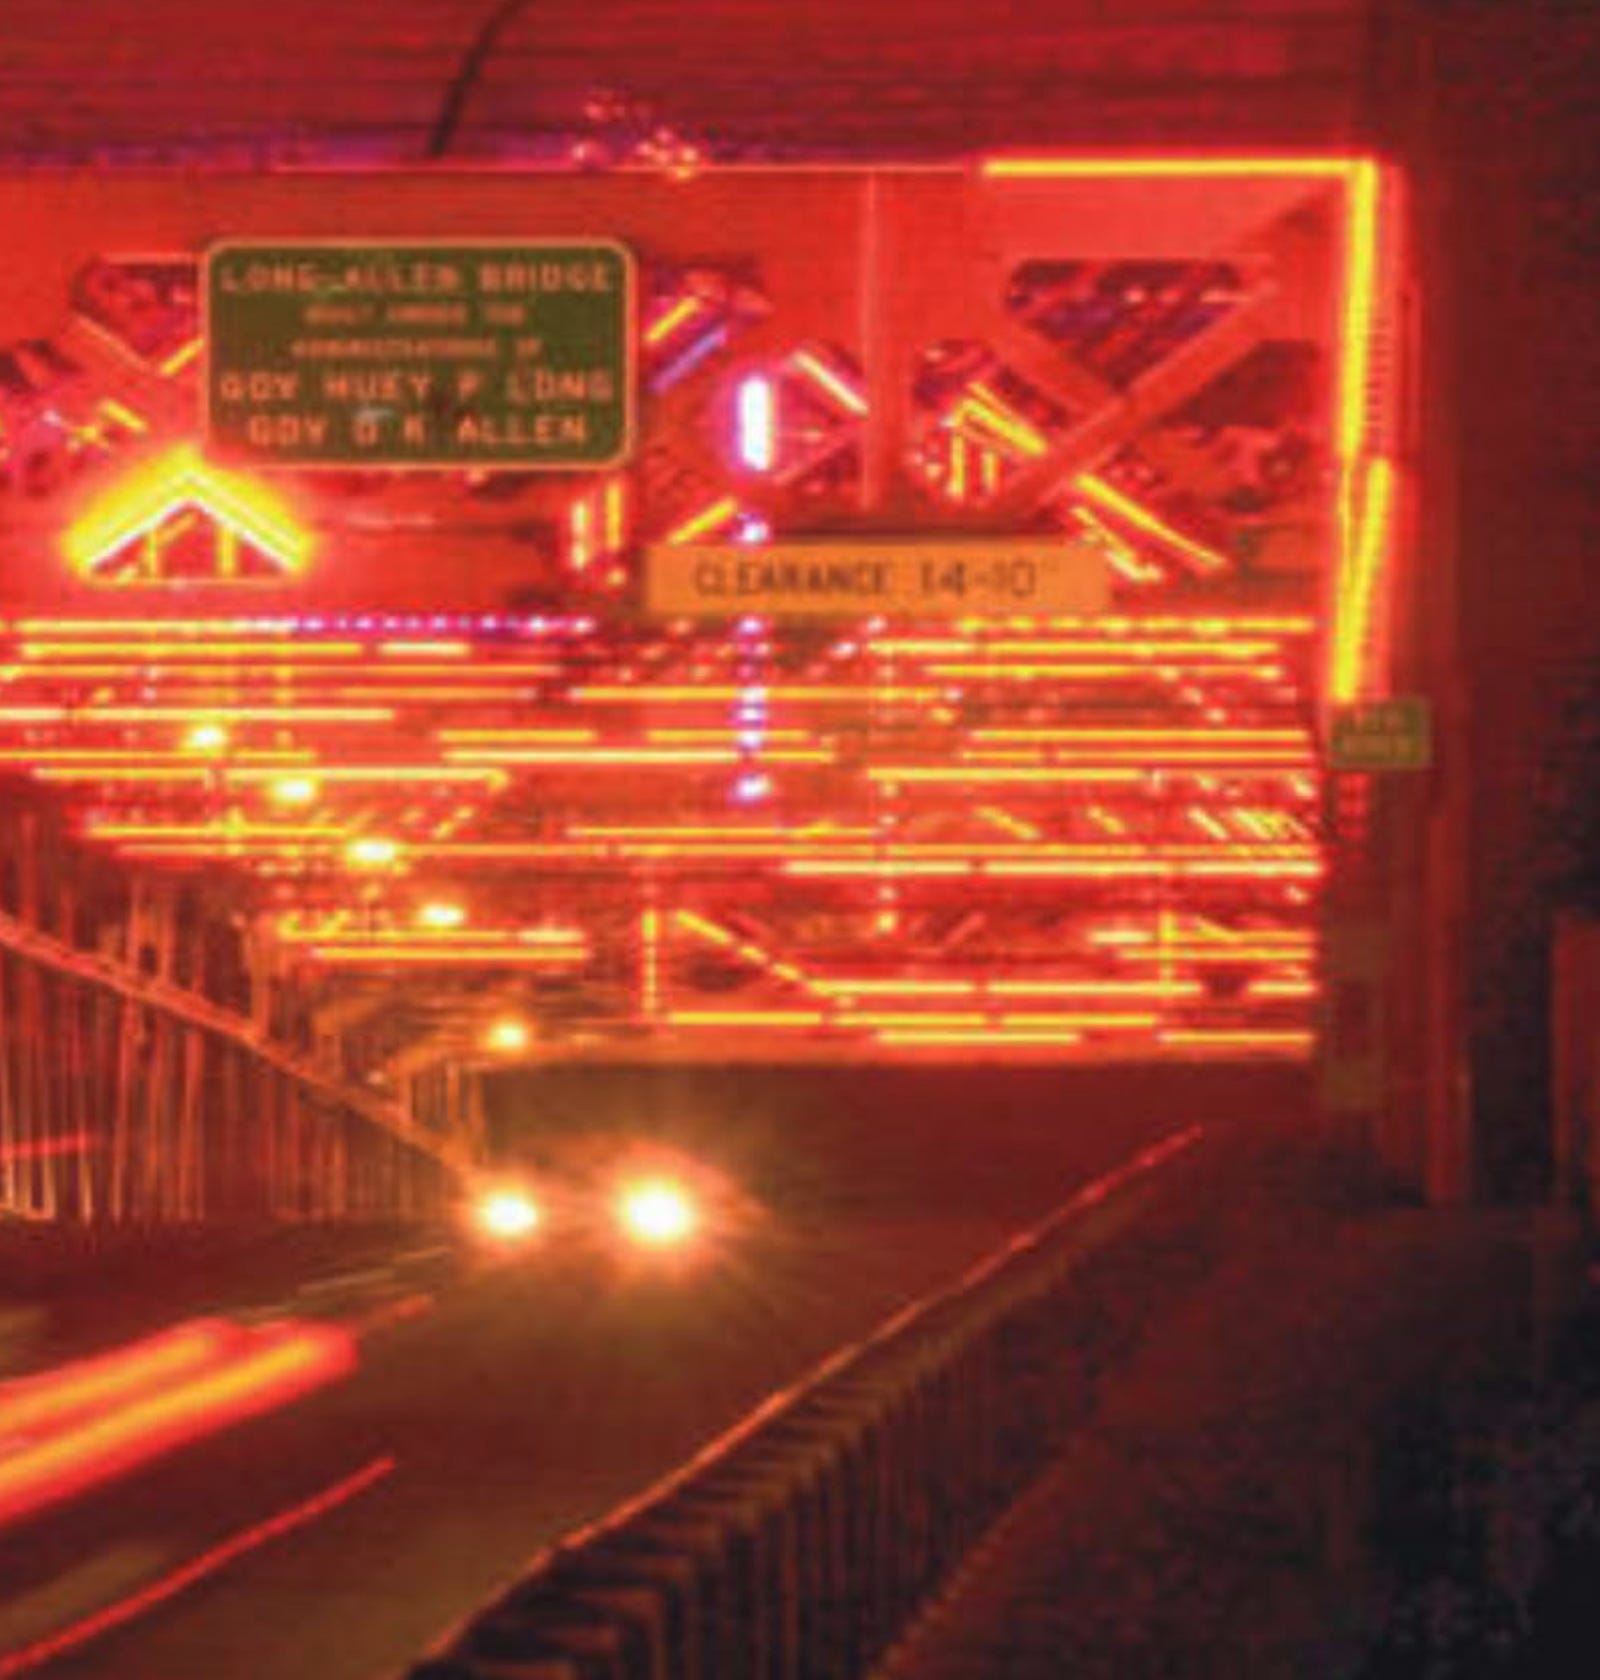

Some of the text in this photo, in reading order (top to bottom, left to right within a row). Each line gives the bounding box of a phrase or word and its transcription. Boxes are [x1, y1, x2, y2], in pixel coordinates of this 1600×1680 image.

[480, 263, 610, 292] BRIDGE
[219, 369, 613, 400] GOV HUEY P LONG
[248, 414, 328, 444] GOV
[456, 414, 587, 444] ALLEN
[694, 559, 889, 598] CLEARANCE
